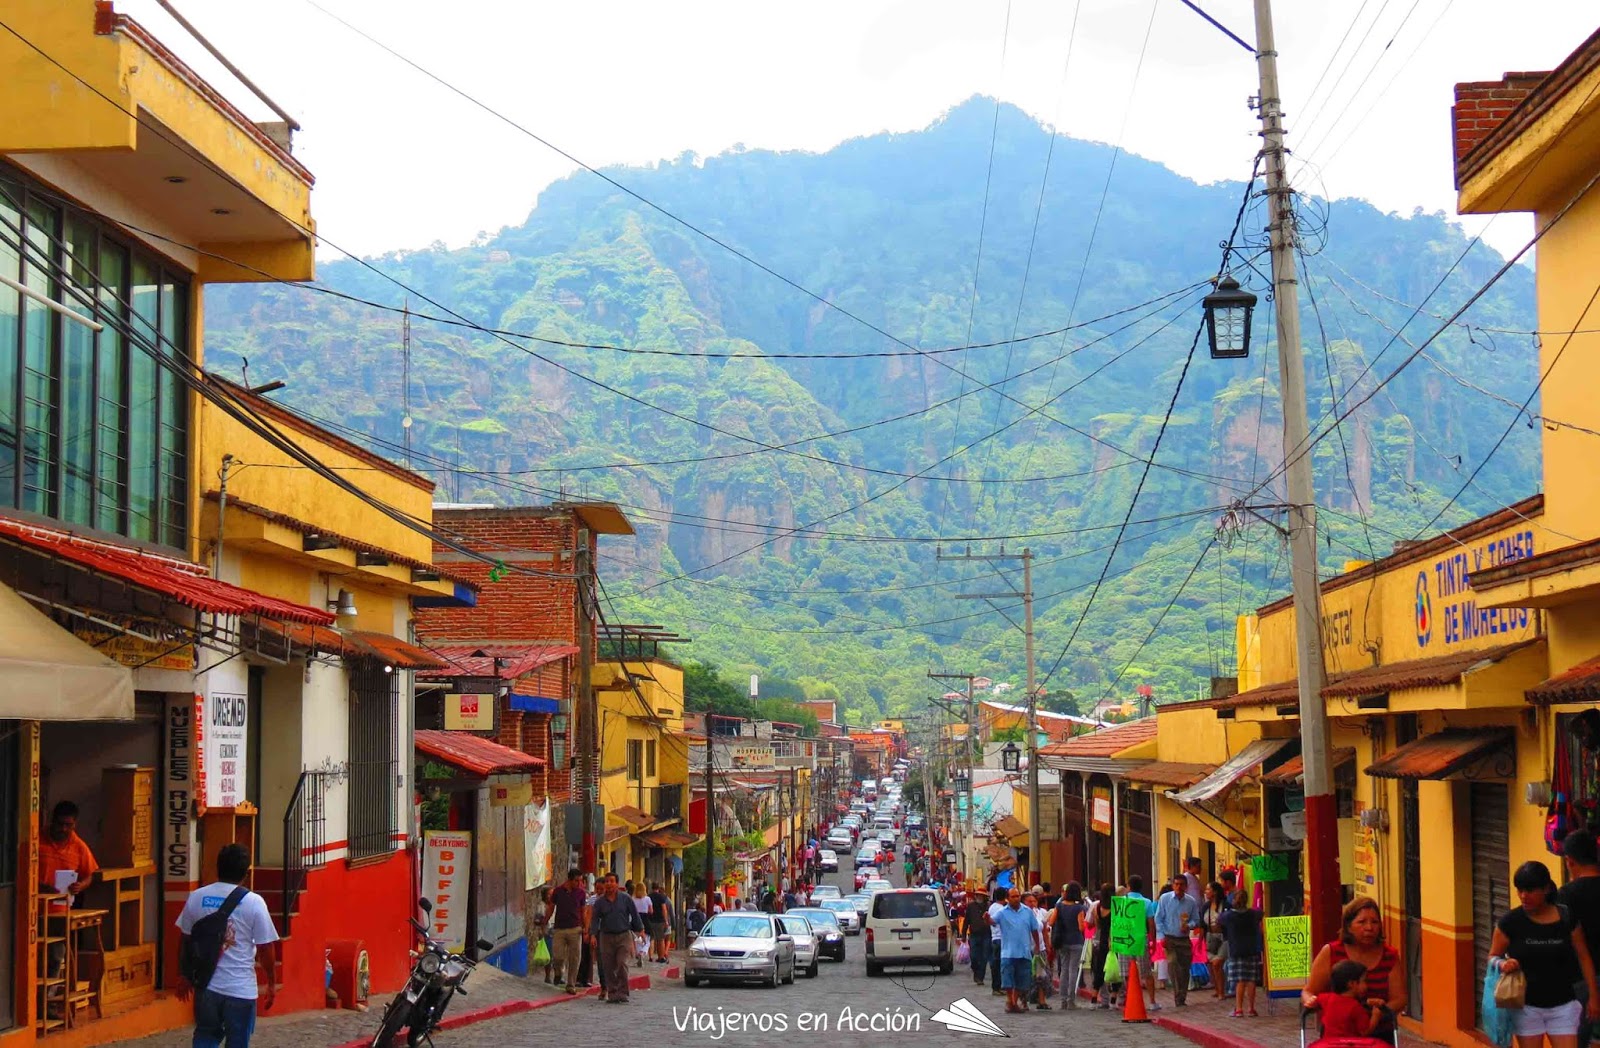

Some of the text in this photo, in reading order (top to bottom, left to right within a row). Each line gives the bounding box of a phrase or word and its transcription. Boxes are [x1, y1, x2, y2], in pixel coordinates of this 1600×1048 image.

[1436, 553, 1471, 598] TINTA
[1472, 547, 1483, 571] Y
[1445, 600, 1528, 643] DE MORELOS
[212, 696, 246, 727] URGEMED
[168, 706, 189, 877] MUEBLES RUSTICOS
[429, 839, 469, 848] DESAYUNOS
[434, 850, 455, 933] BUFFET
[1112, 898, 1139, 919] WC
[1277, 931, 1305, 945] $350
